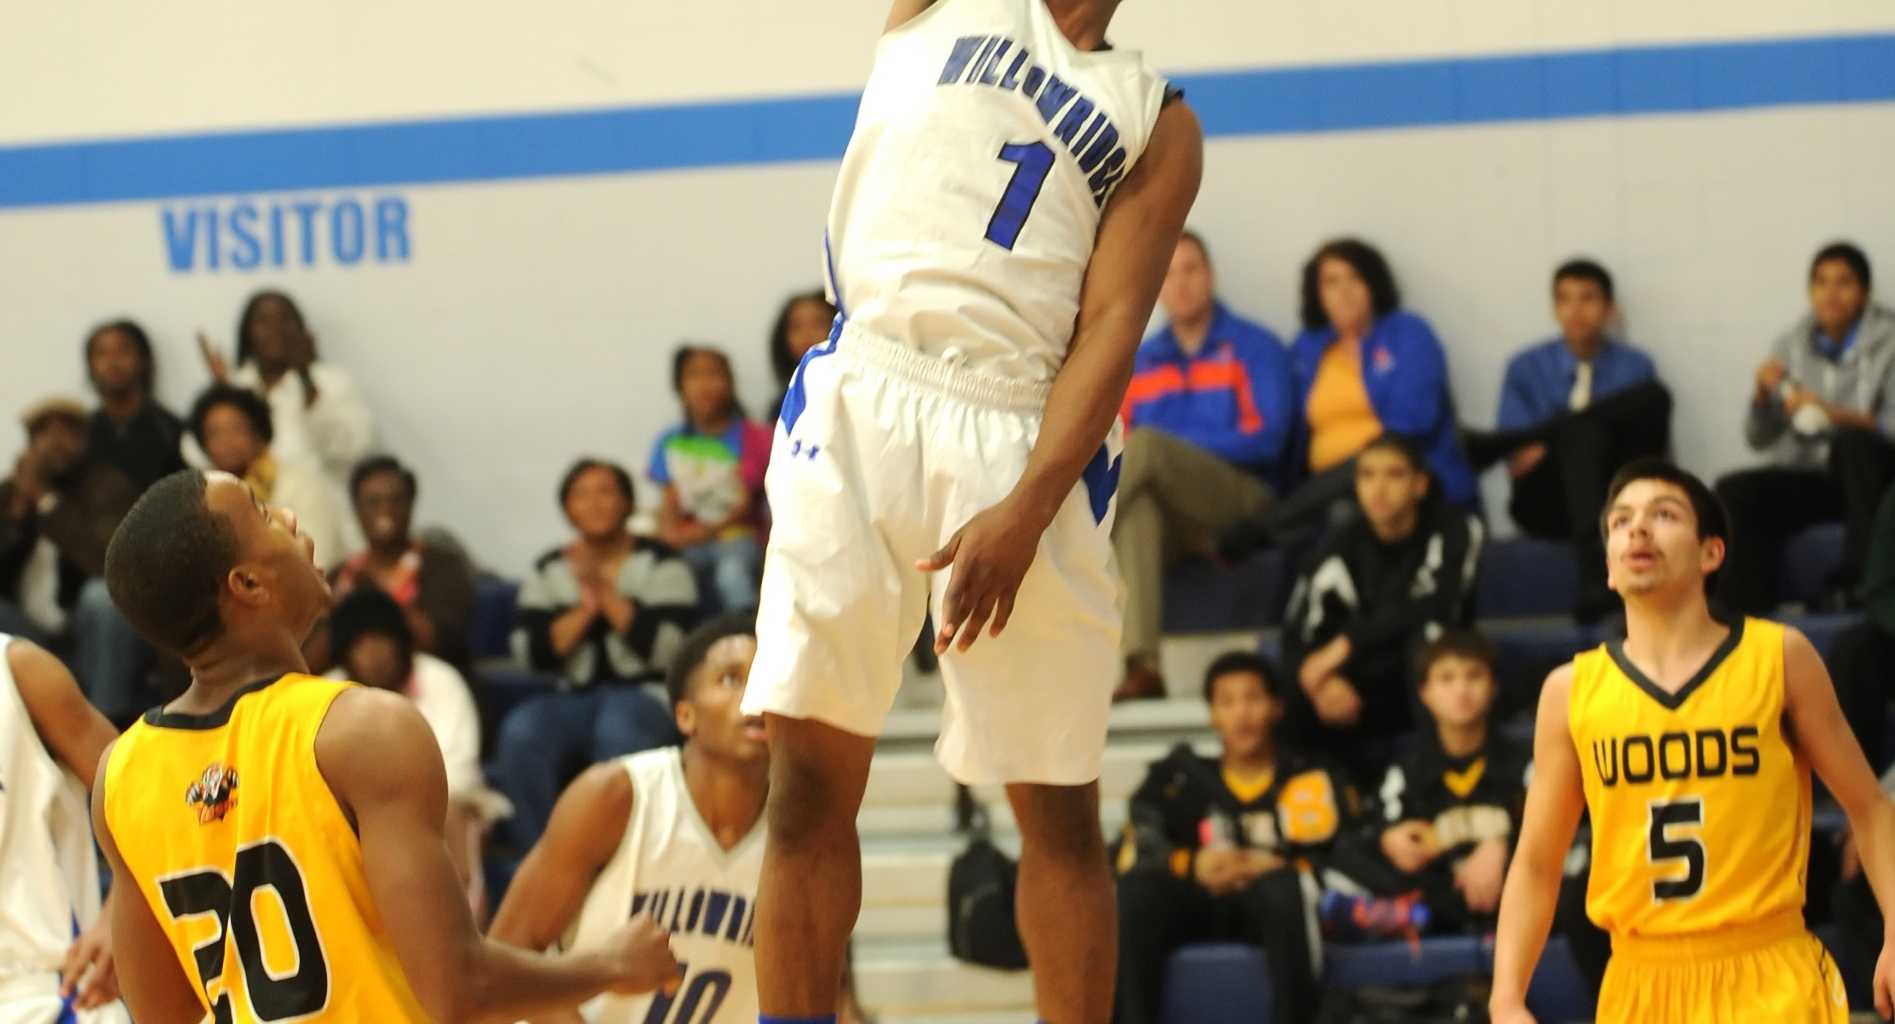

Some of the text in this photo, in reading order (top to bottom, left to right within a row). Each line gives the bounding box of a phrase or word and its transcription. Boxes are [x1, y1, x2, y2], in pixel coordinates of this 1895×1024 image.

[161, 195, 411, 271] VISITOR
[985, 140, 1056, 250] 1
[1593, 726, 1760, 787] WOODS
[1649, 798, 1705, 901] 5
[155, 835, 330, 1024] 20
